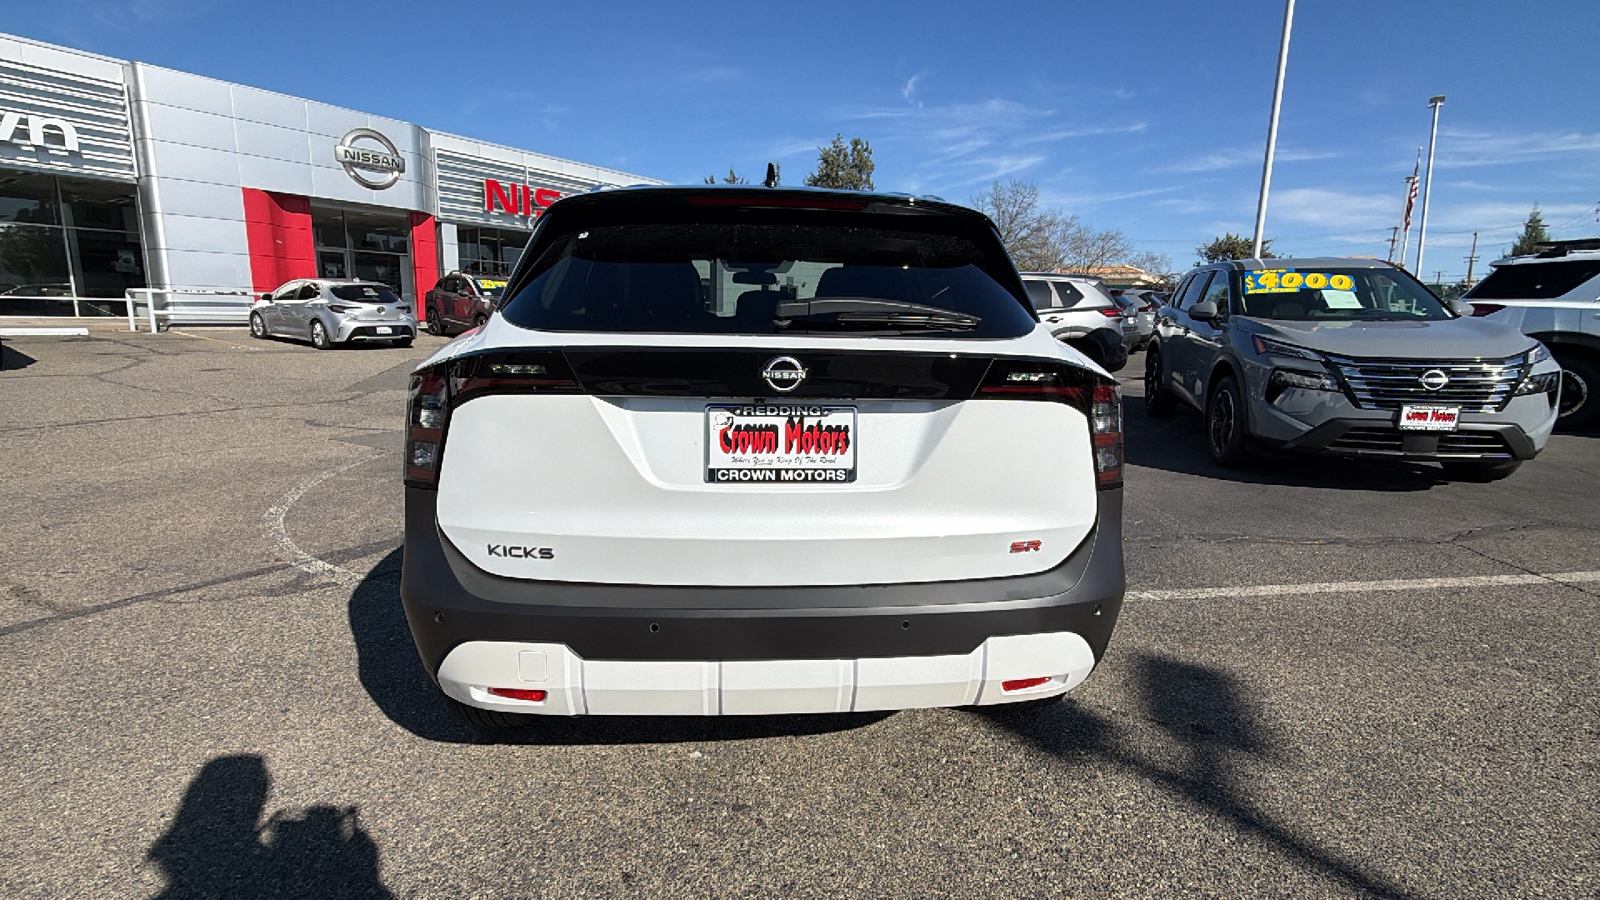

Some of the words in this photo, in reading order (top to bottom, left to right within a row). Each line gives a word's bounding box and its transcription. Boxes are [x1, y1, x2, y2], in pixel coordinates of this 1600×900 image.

[343, 149, 400, 169] NISSAN
[743, 406, 820, 416] REDDING
[719, 421, 777, 454] Crown
[785, 420, 848, 455] Motors
[776, 456, 792, 465] King
[794, 456, 803, 465] Of
[717, 469, 776, 481] CROWN
[780, 470, 846, 481] MOTORS
[487, 543, 555, 560] KICKS
[1009, 540, 1042, 553] SR
